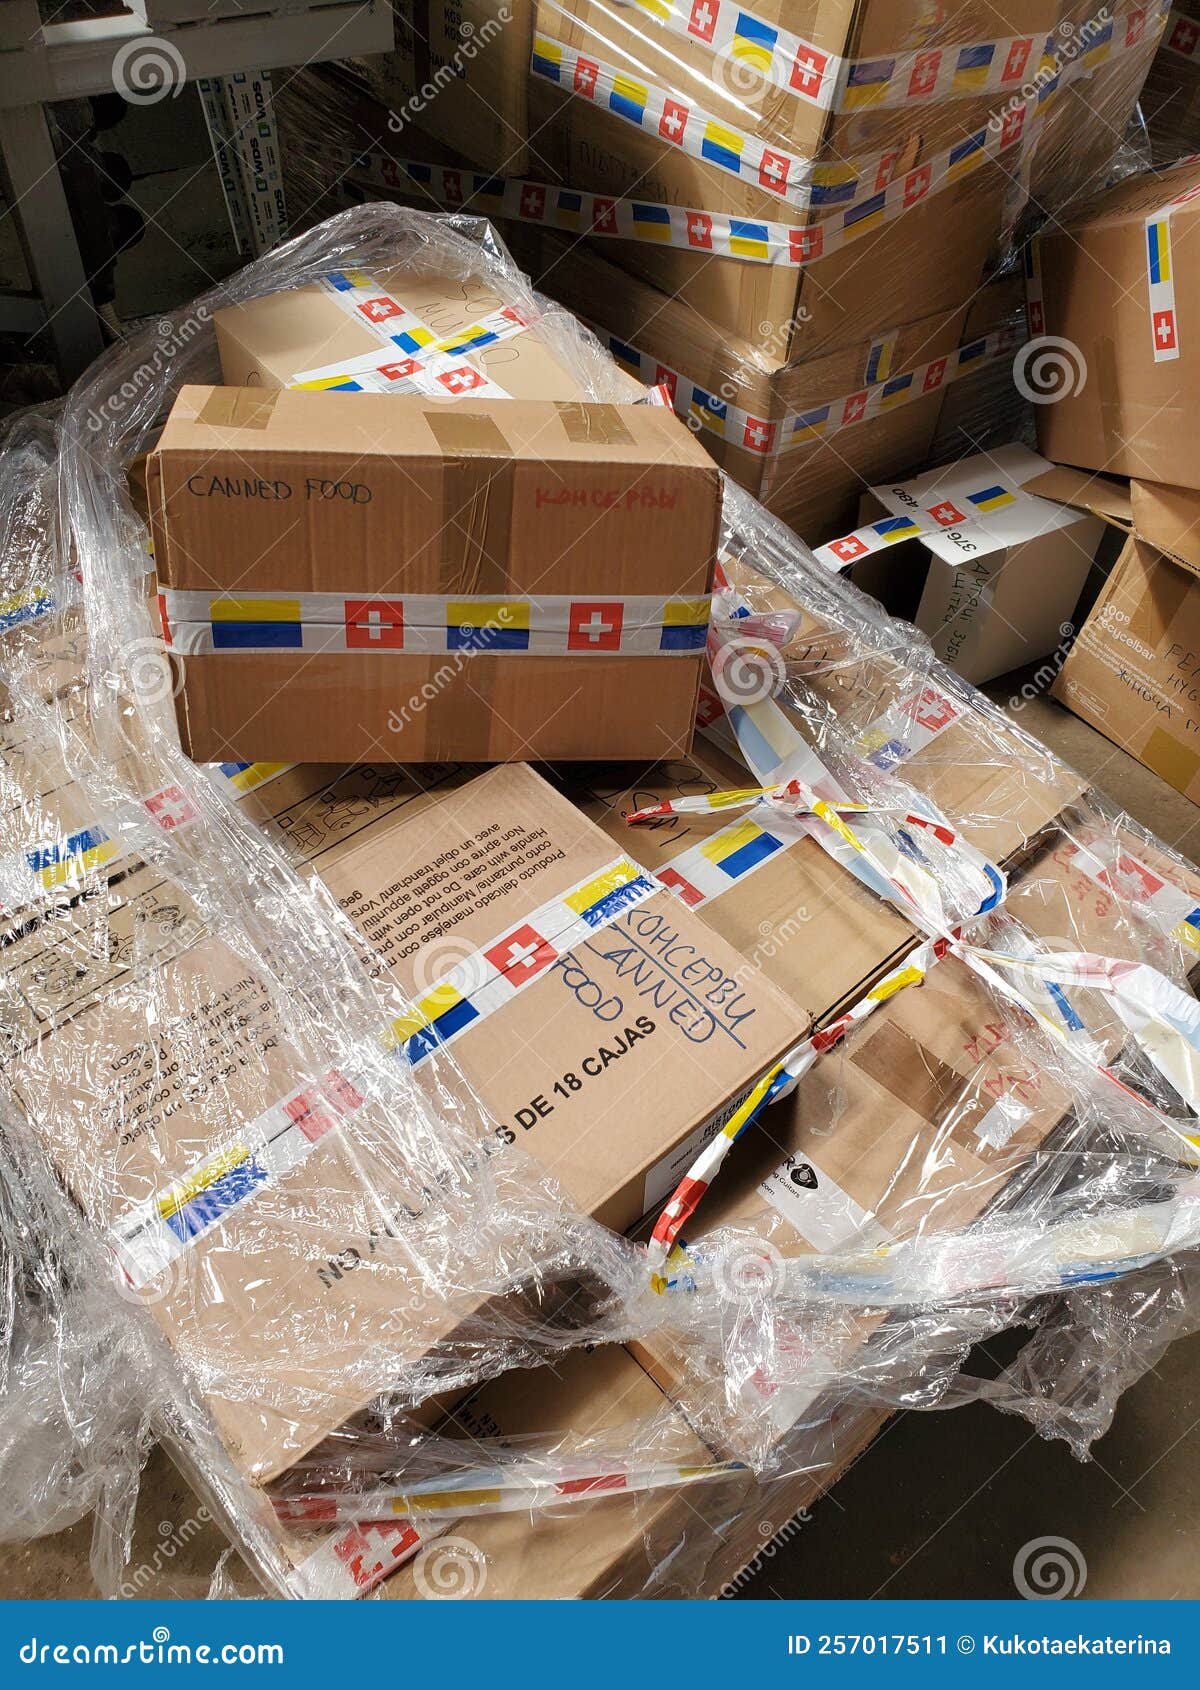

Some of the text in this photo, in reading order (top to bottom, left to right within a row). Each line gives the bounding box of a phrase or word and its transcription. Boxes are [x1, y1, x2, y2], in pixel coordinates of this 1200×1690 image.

[251, 80, 266, 119] WDS
[250, 137, 263, 174] WDS
[273, 188, 287, 225] WDS
[188, 475, 373, 505] CANNED FOOD
[459, 839, 475, 850] un
[475, 823, 500, 841] avec
[501, 825, 526, 841] Non
[432, 848, 460, 868] objet
[470, 839, 501, 860] aprire
[525, 840, 552, 859] corto
[449, 858, 470, 873] con
[475, 857, 526, 892] punzante/
[519, 850, 566, 880] Producto
[368, 827, 548, 941] Handle with care. Do not open with
[412, 871, 450, 896] oggetti
[474, 879, 518, 908] delicado
[421, 889, 476, 926] Manipular
[394, 923, 420, 942] com
[397, 942, 420, 959] con
[551, 951, 624, 1022] FOOD
[514, 1094, 555, 1131] DE
[552, 1073, 583, 1099] 18
[581, 1015, 657, 1077] CAJAS
[316, 1248, 361, 1290] NO
